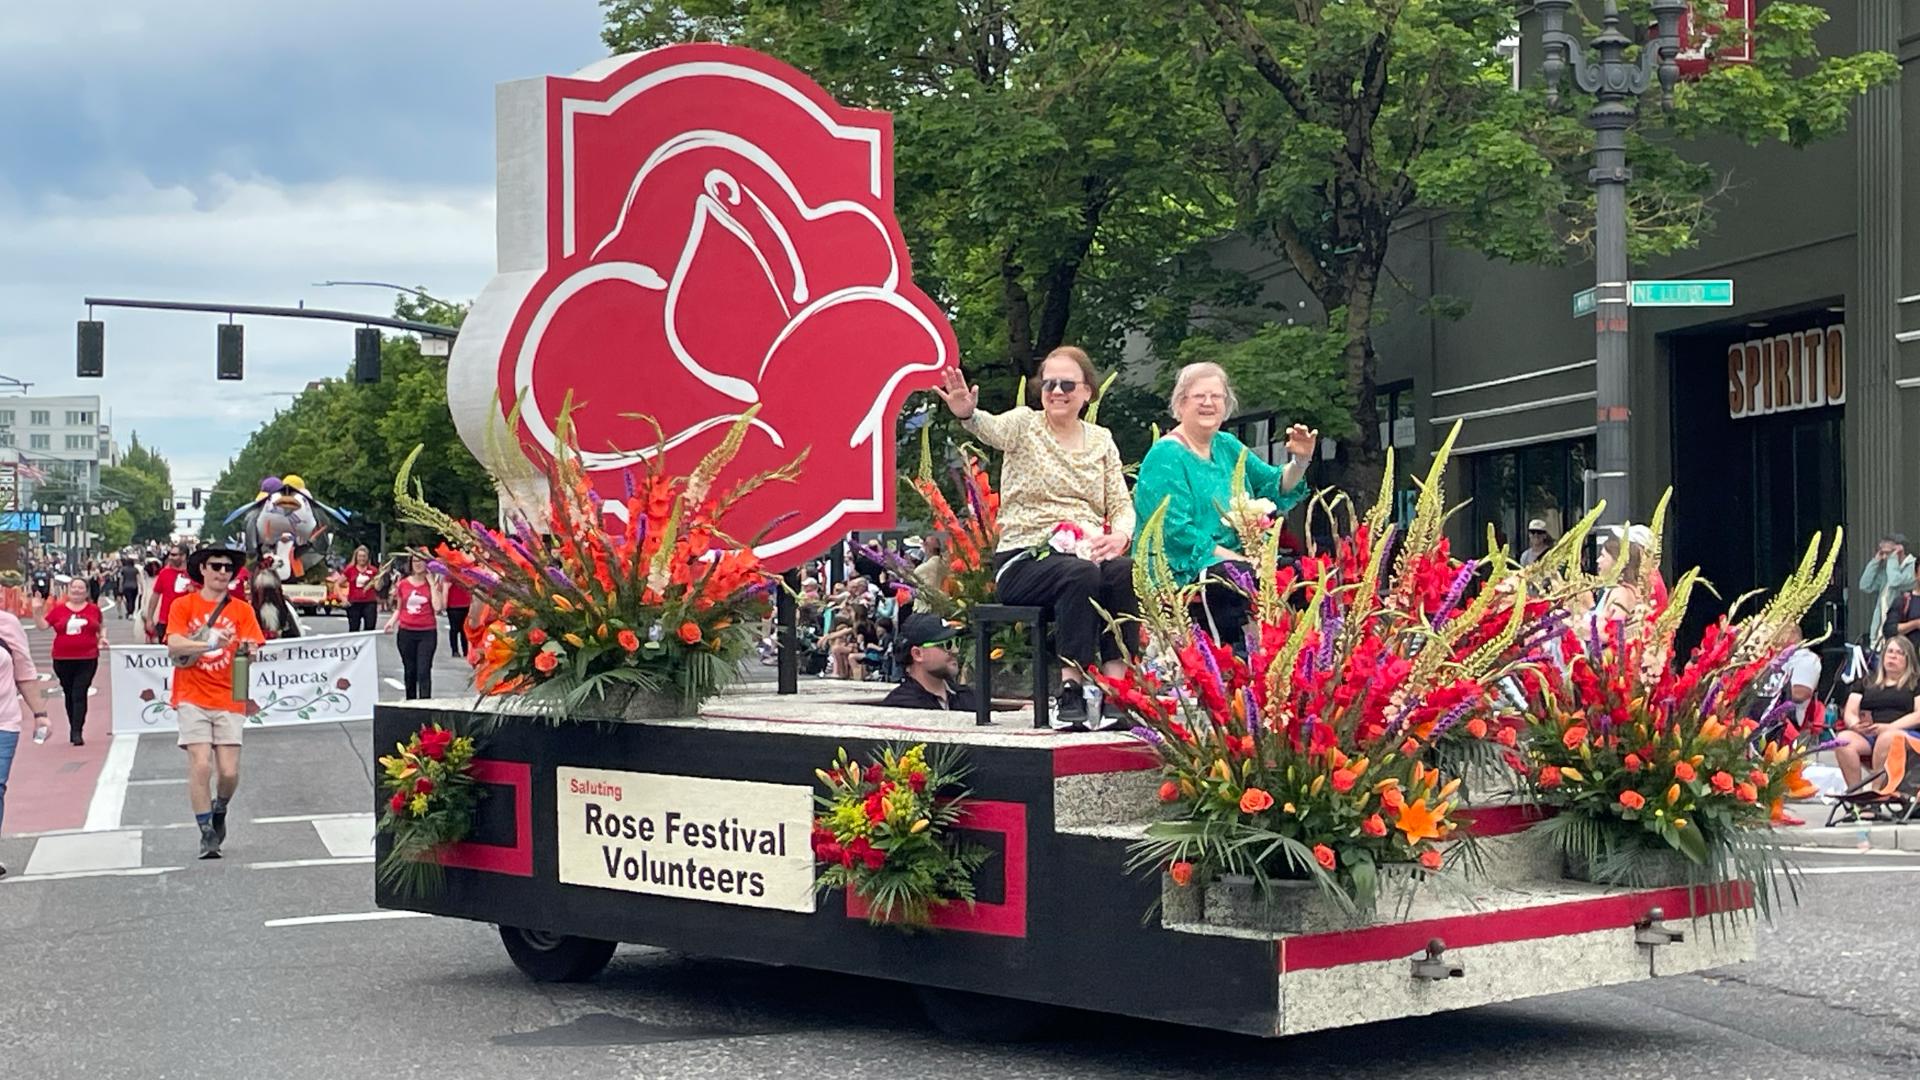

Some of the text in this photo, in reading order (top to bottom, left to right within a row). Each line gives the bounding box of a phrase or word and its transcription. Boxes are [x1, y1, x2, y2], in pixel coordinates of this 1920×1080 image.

[1729, 324, 1846, 419] SPIRITO
[125, 654, 169, 669] Mou
[283, 646, 363, 662] Therapy
[256, 670, 328, 689] Alpacas
[570, 778, 623, 801] Saluting
[585, 803, 787, 857] Rose Festival
[602, 845, 765, 897] Volunteers
